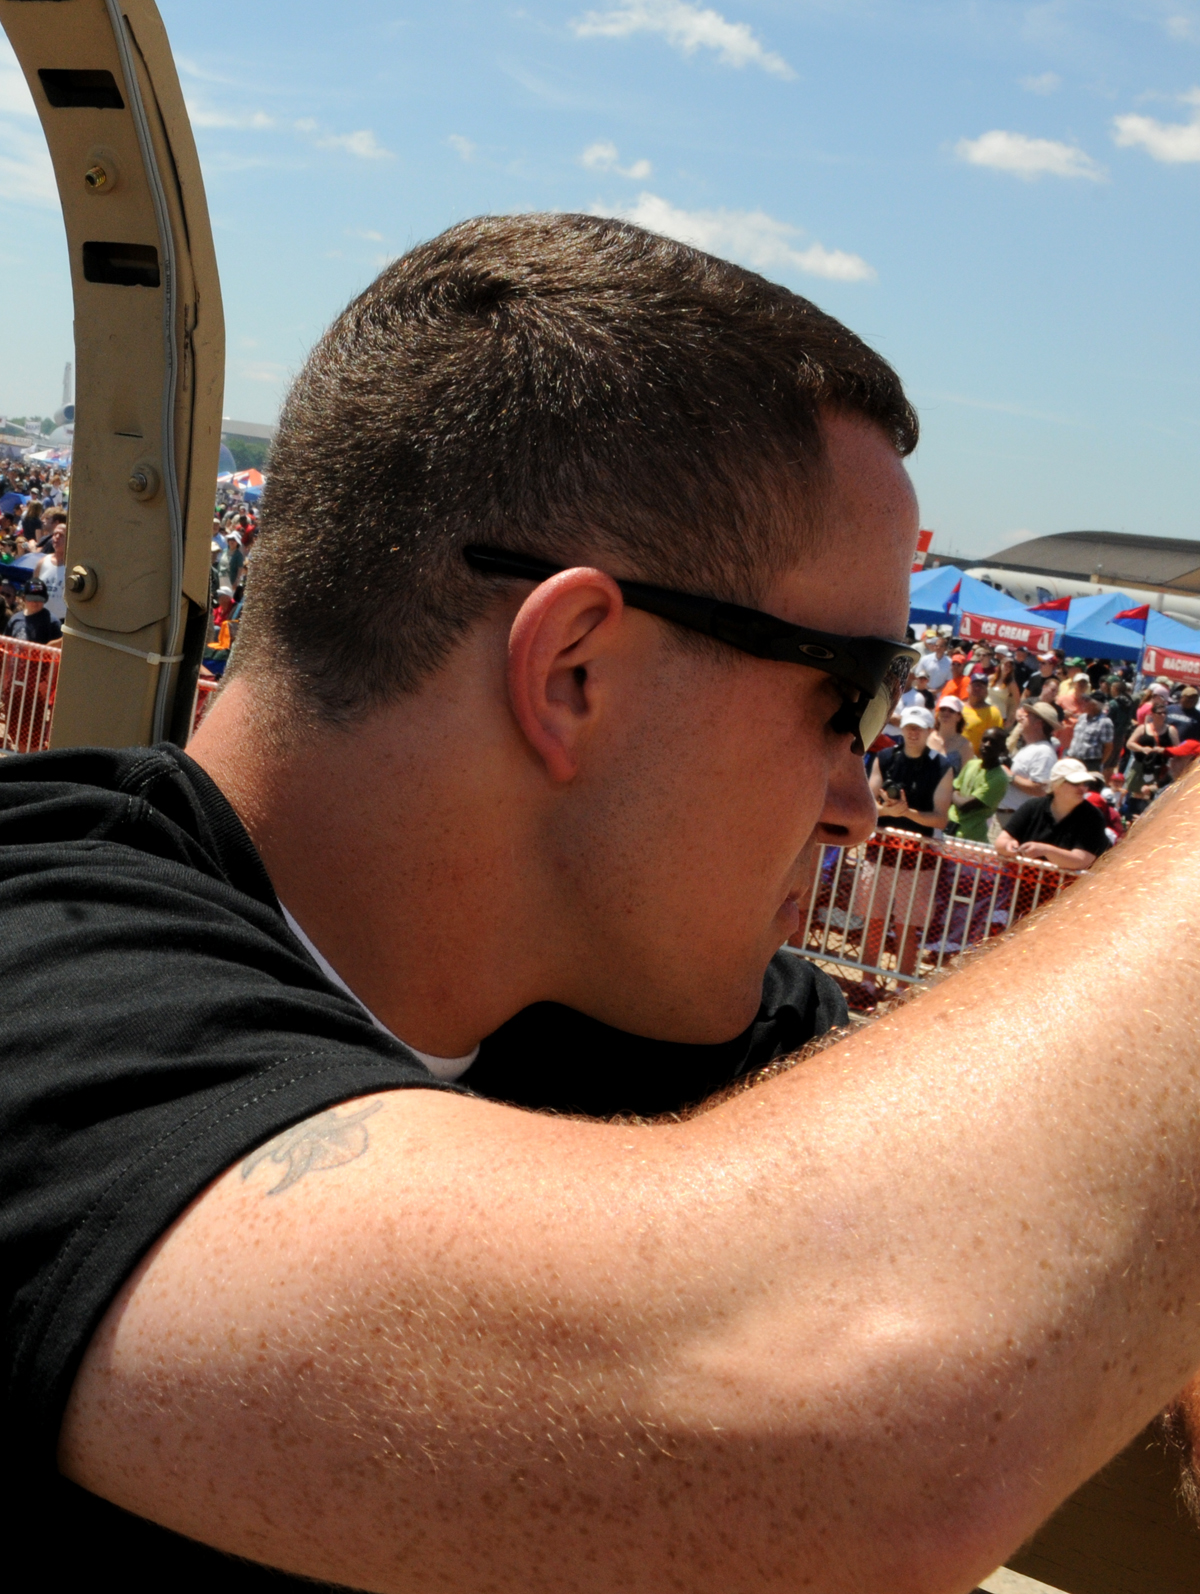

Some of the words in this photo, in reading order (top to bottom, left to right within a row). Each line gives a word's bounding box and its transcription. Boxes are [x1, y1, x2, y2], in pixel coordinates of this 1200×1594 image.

[981, 621, 998, 636] ICE
[998, 624, 1031, 642] CREAM
[1162, 657, 1200, 674] NACHOS
